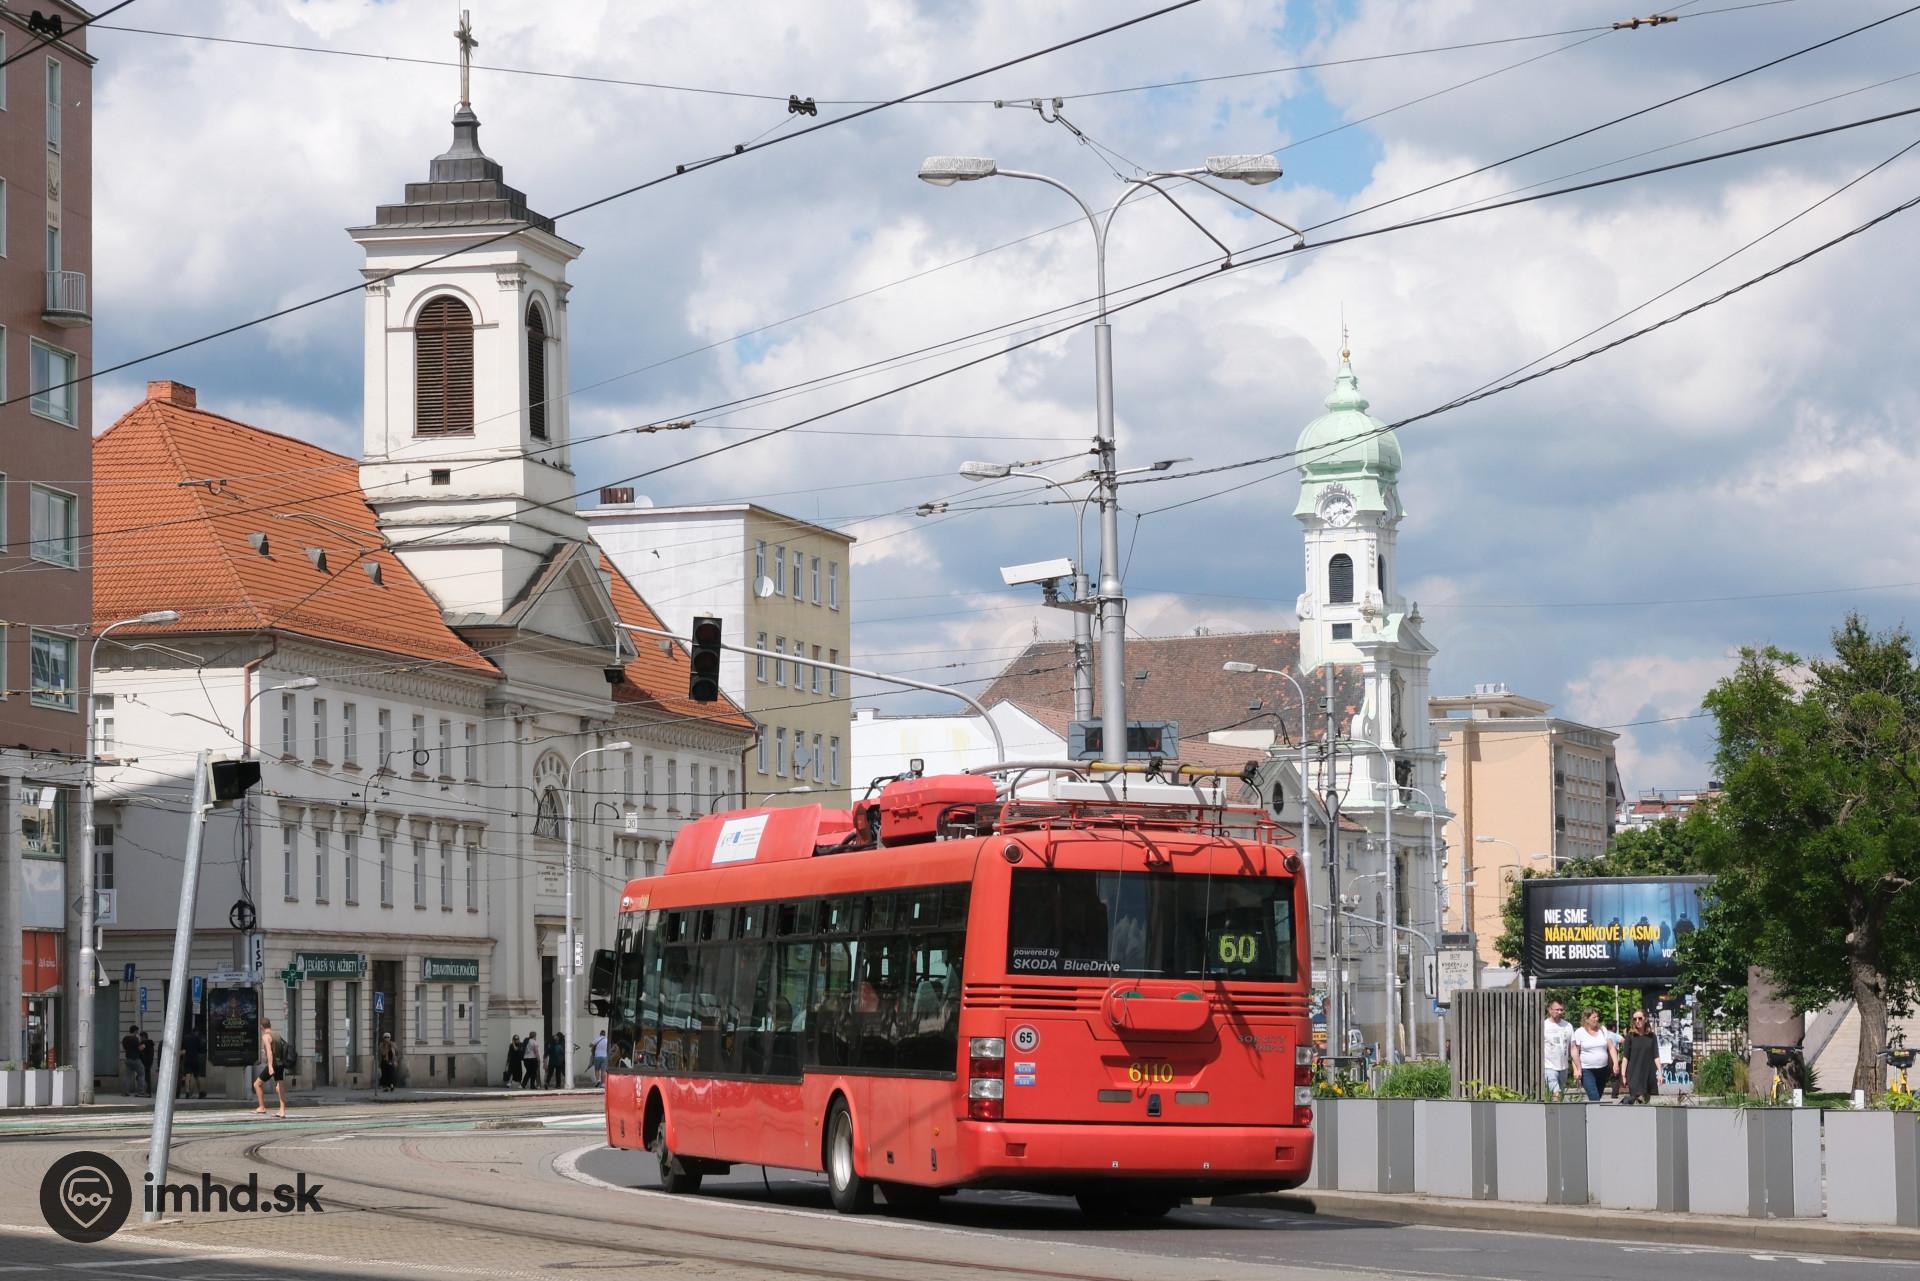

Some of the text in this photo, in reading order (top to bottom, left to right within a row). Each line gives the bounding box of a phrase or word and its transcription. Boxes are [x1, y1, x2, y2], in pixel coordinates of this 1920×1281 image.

[627, 819, 636, 829] 30
[1544, 908, 1588, 924] NIE SME
[1544, 924, 1661, 942] NÁRAZNÍKOVÉ PÁSMO
[1013, 948, 1060, 958] powered by
[1219, 935, 1256, 963] 60
[1545, 944, 1610, 960] PRE BRUSEL
[1063, 960, 1120, 972] BlueDrive
[1019, 1031, 1033, 1043] 65
[1128, 1062, 1174, 1083] 6110
